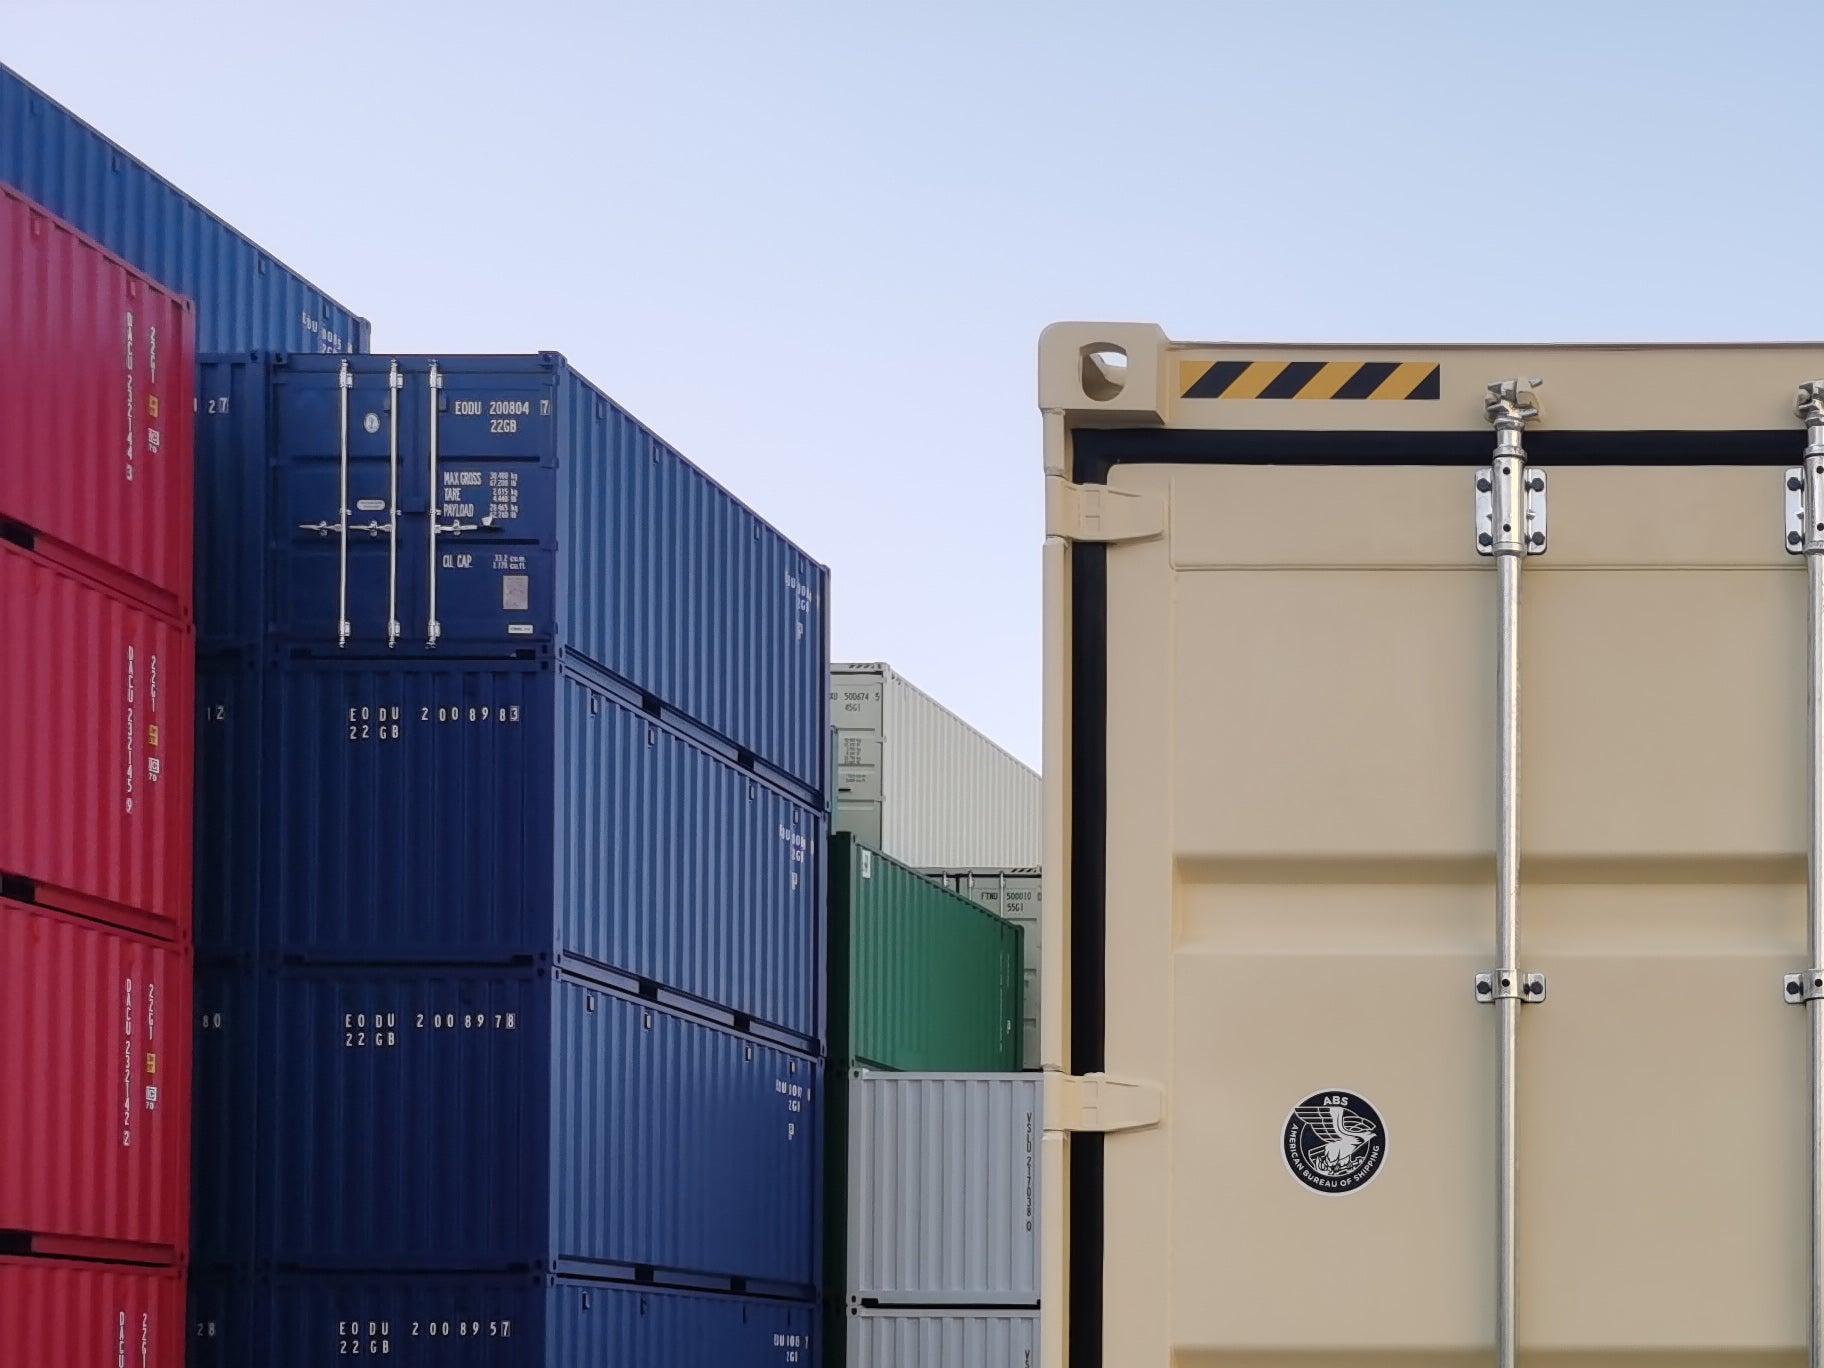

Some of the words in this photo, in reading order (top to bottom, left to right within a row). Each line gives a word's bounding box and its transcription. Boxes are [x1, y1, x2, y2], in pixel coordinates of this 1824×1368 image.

[455, 401, 482, 415] EODU
[489, 401, 530, 415] 200804
[490, 419, 517, 433] 22GB
[444, 487, 461, 501] TARE
[443, 503, 474, 517] PAYLOAD
[350, 706, 399, 722] EODU
[350, 725, 399, 740] 22GB
[345, 1013, 395, 1029] EODU
[345, 1032, 395, 1047] 22GB
[123, 1039, 131, 1126] 232142
[1323, 1095, 1349, 1106] ABS
[1289, 1123, 1304, 1172] AMERICAN
[1302, 1170, 1338, 1188] BUREAU
[1340, 1177, 1352, 1187] OF
[1353, 1145, 1380, 1182] SHIPPING
[339, 1321, 389, 1337] EODU
[339, 1340, 389, 1354] 22GB
